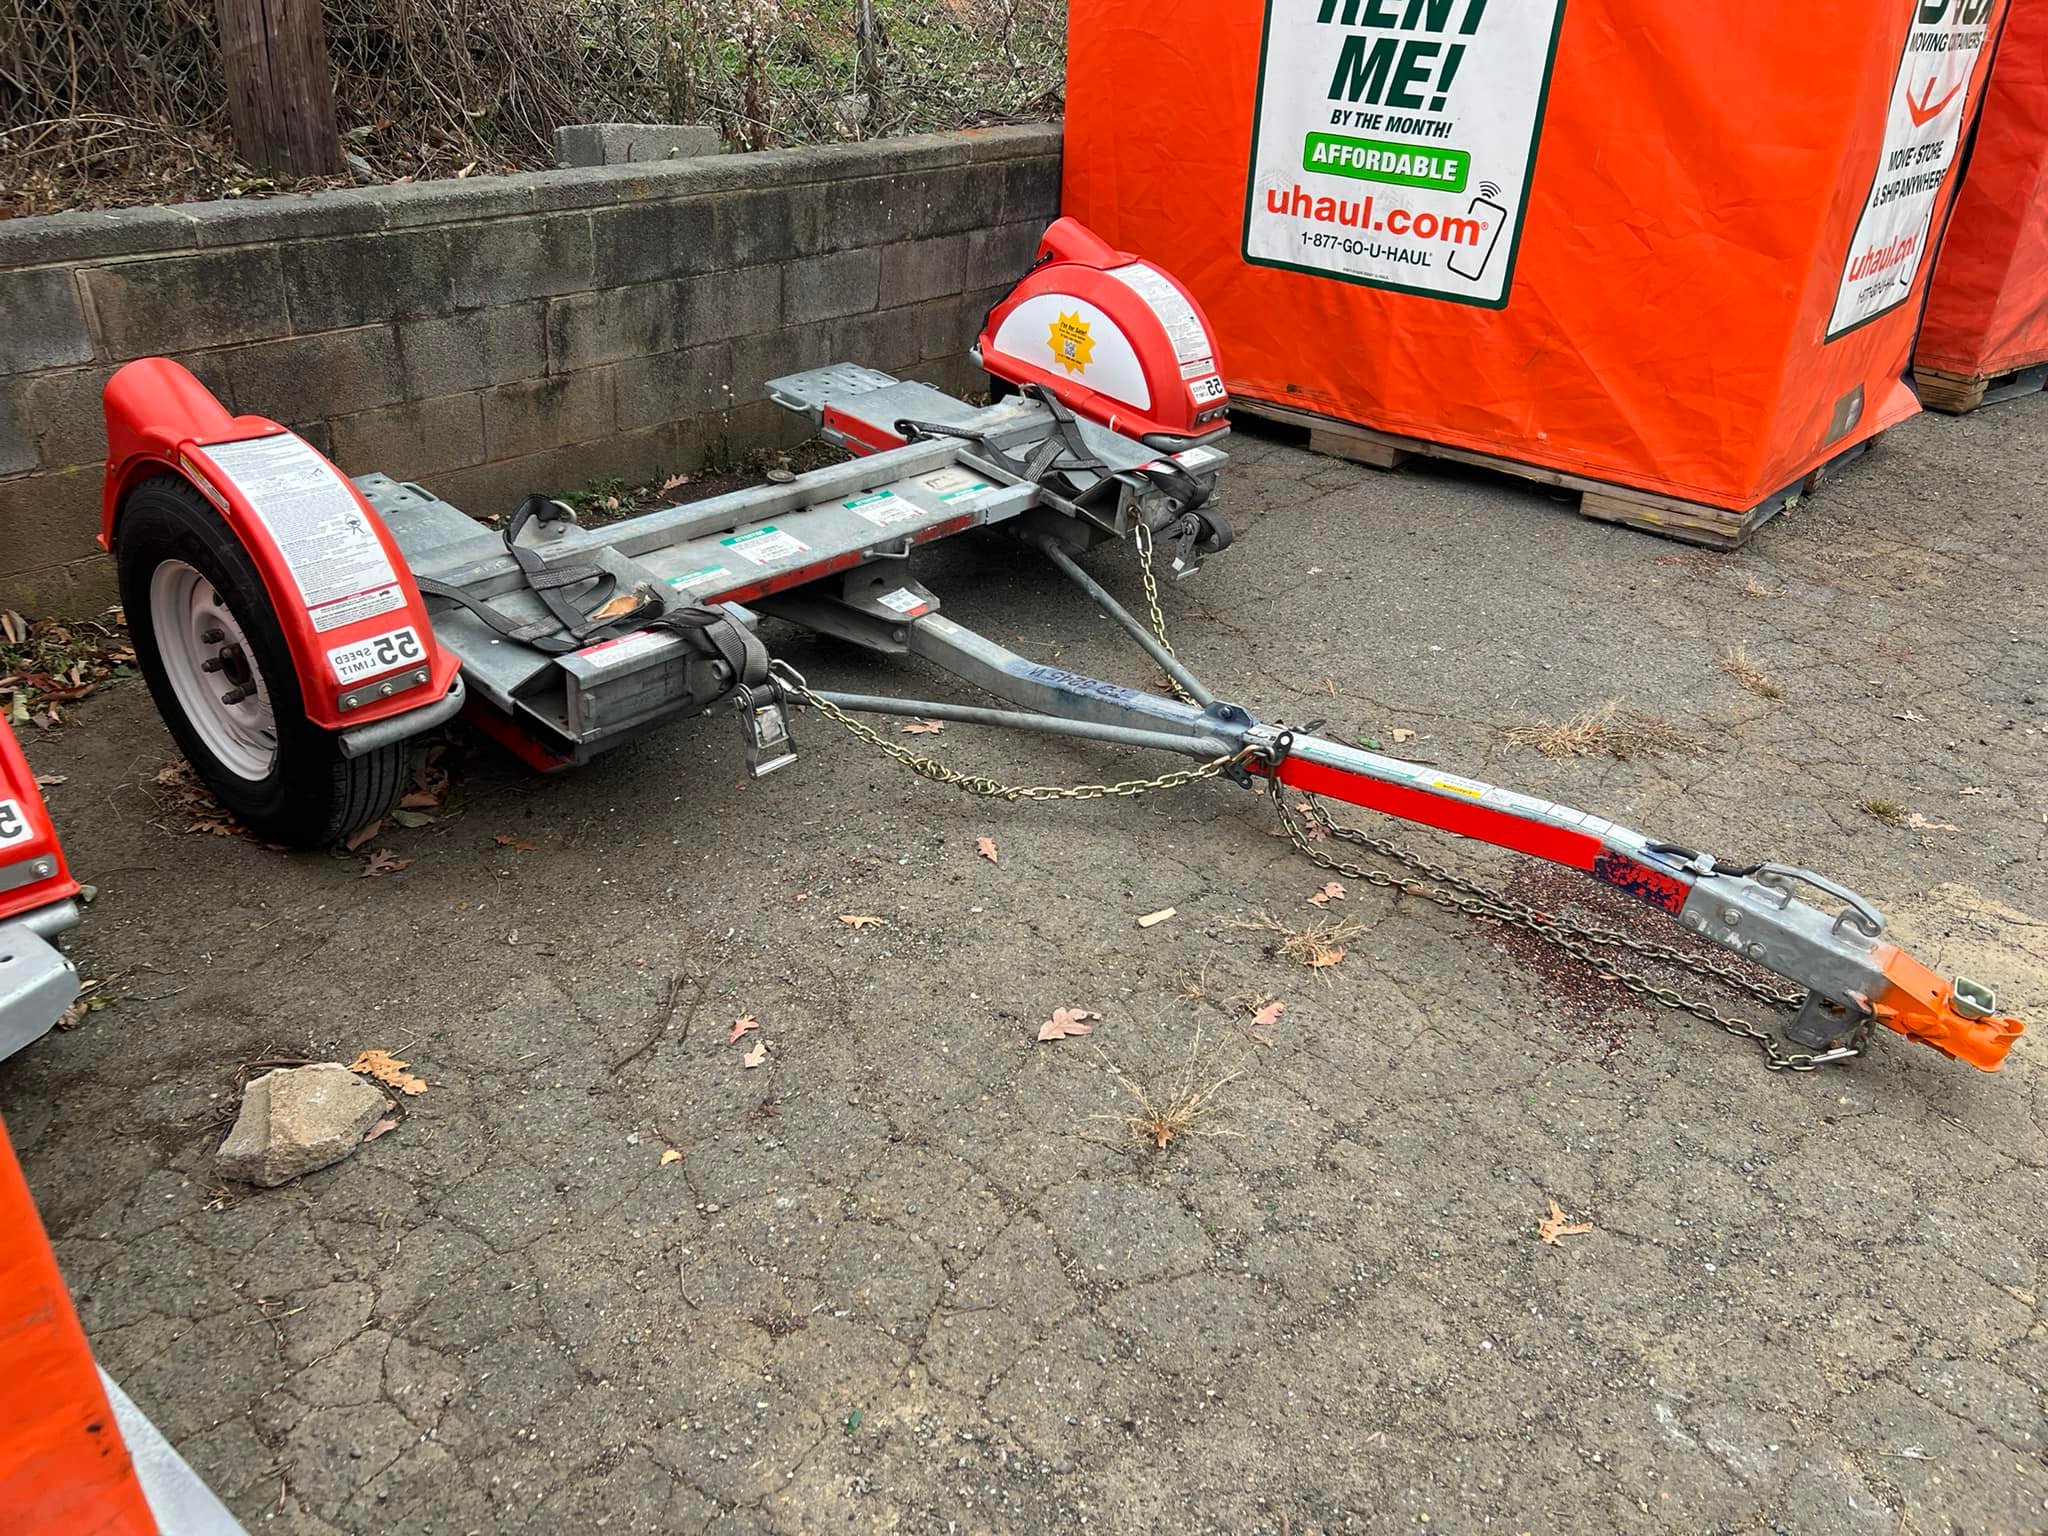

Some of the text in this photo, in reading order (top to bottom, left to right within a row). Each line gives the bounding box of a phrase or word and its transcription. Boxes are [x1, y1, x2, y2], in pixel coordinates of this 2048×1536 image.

[1908, 31, 1949, 53] MOVING
[1327, 35, 1467, 112] ME!
[1330, 108, 1454, 138] BY THE MONTH!
[1312, 142, 1459, 182] AFFORDABLE
[1879, 184, 1899, 207] SHIP
[1301, 232, 1433, 267] 1-877-GO-U-HAUL
